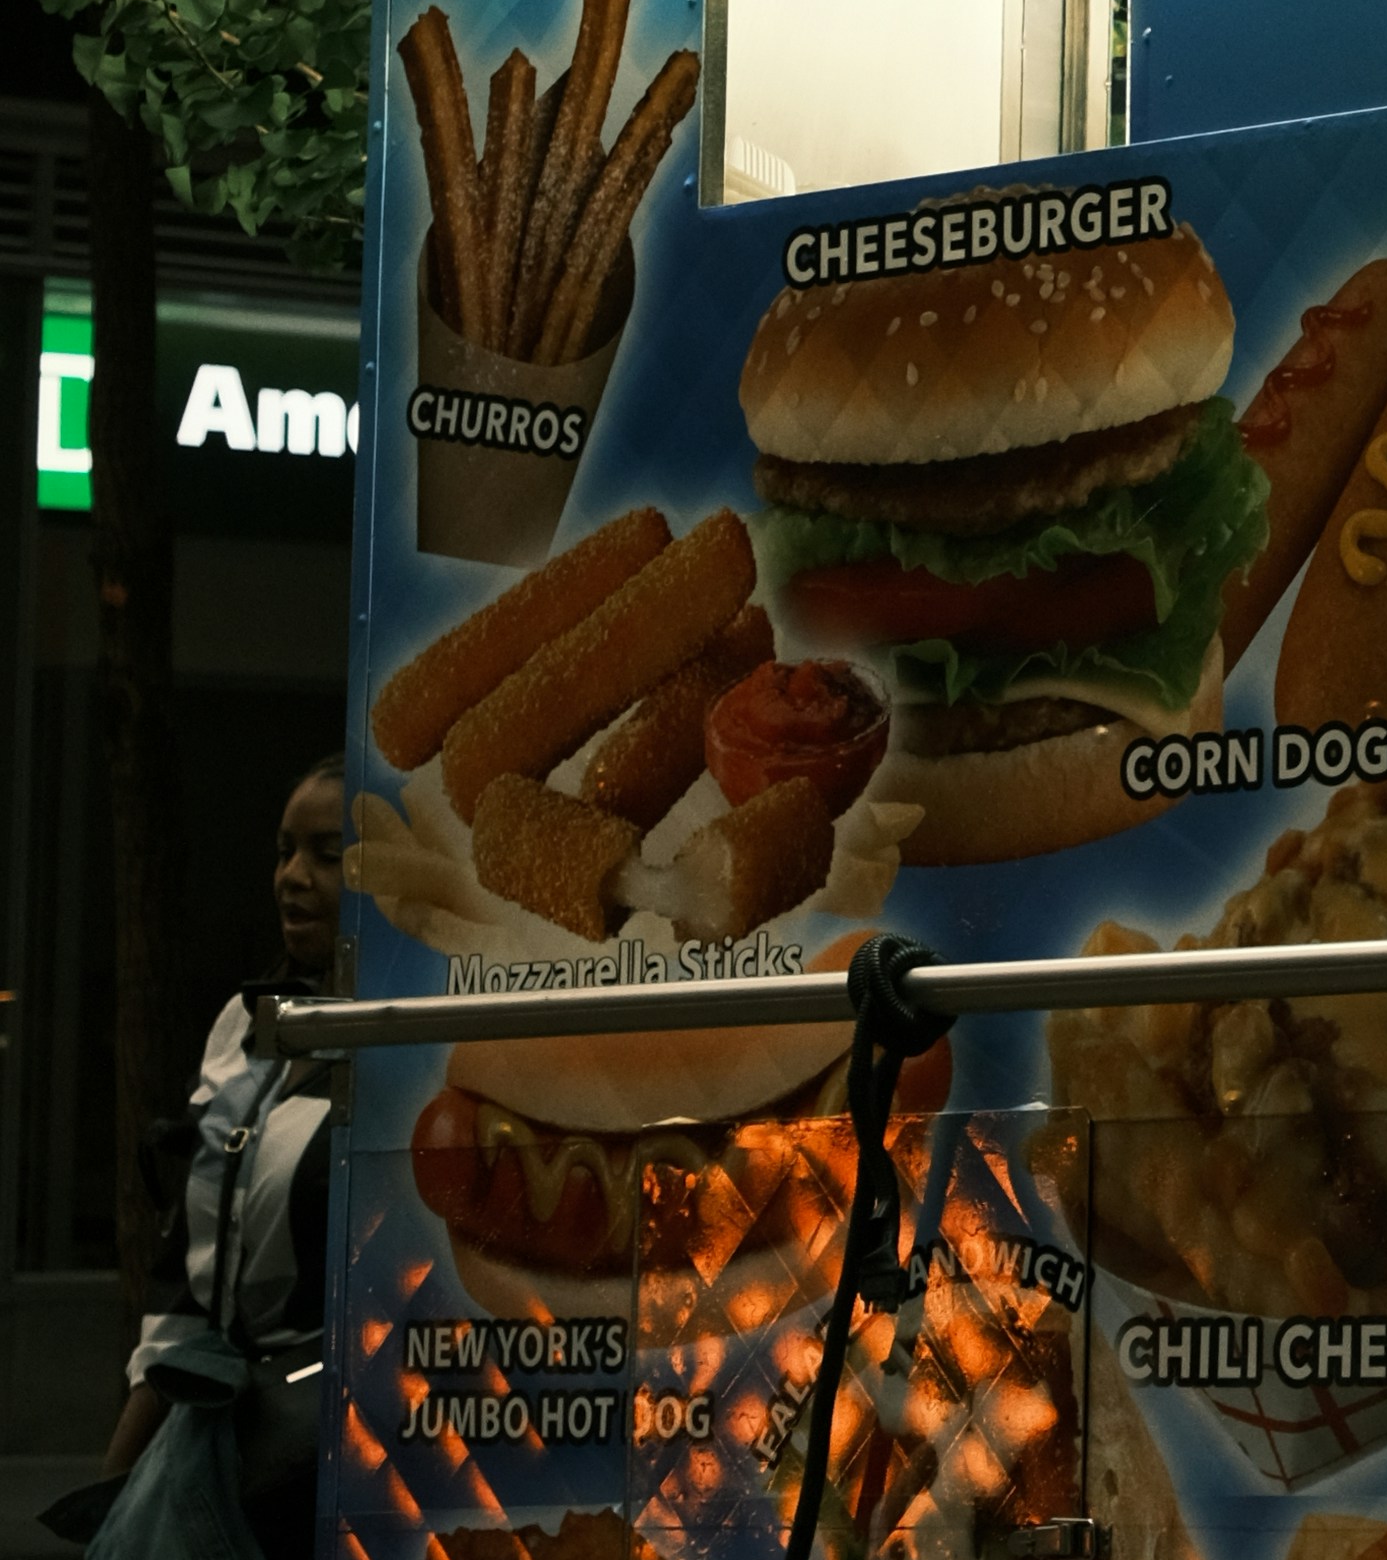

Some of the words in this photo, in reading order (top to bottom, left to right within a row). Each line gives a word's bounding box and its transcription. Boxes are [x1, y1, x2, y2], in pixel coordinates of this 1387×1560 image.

[786, 182, 1173, 281] CHEESEBURGER
[177, 363, 359, 458] Am
[408, 391, 585, 456] CHURROS
[1124, 735, 1261, 796] CORN
[446, 936, 666, 993] Mozzarella
[677, 933, 804, 983] Sticks
[908, 1235, 1086, 1306] ANDWICH
[406, 1326, 487, 1368] NEW
[499, 1323, 625, 1368] YORK'S
[1120, 1321, 1261, 1382] CHILI
[402, 1395, 530, 1439] JUMBO
[542, 1395, 615, 1439] HOT
[633, 1392, 711, 1443] DOG
